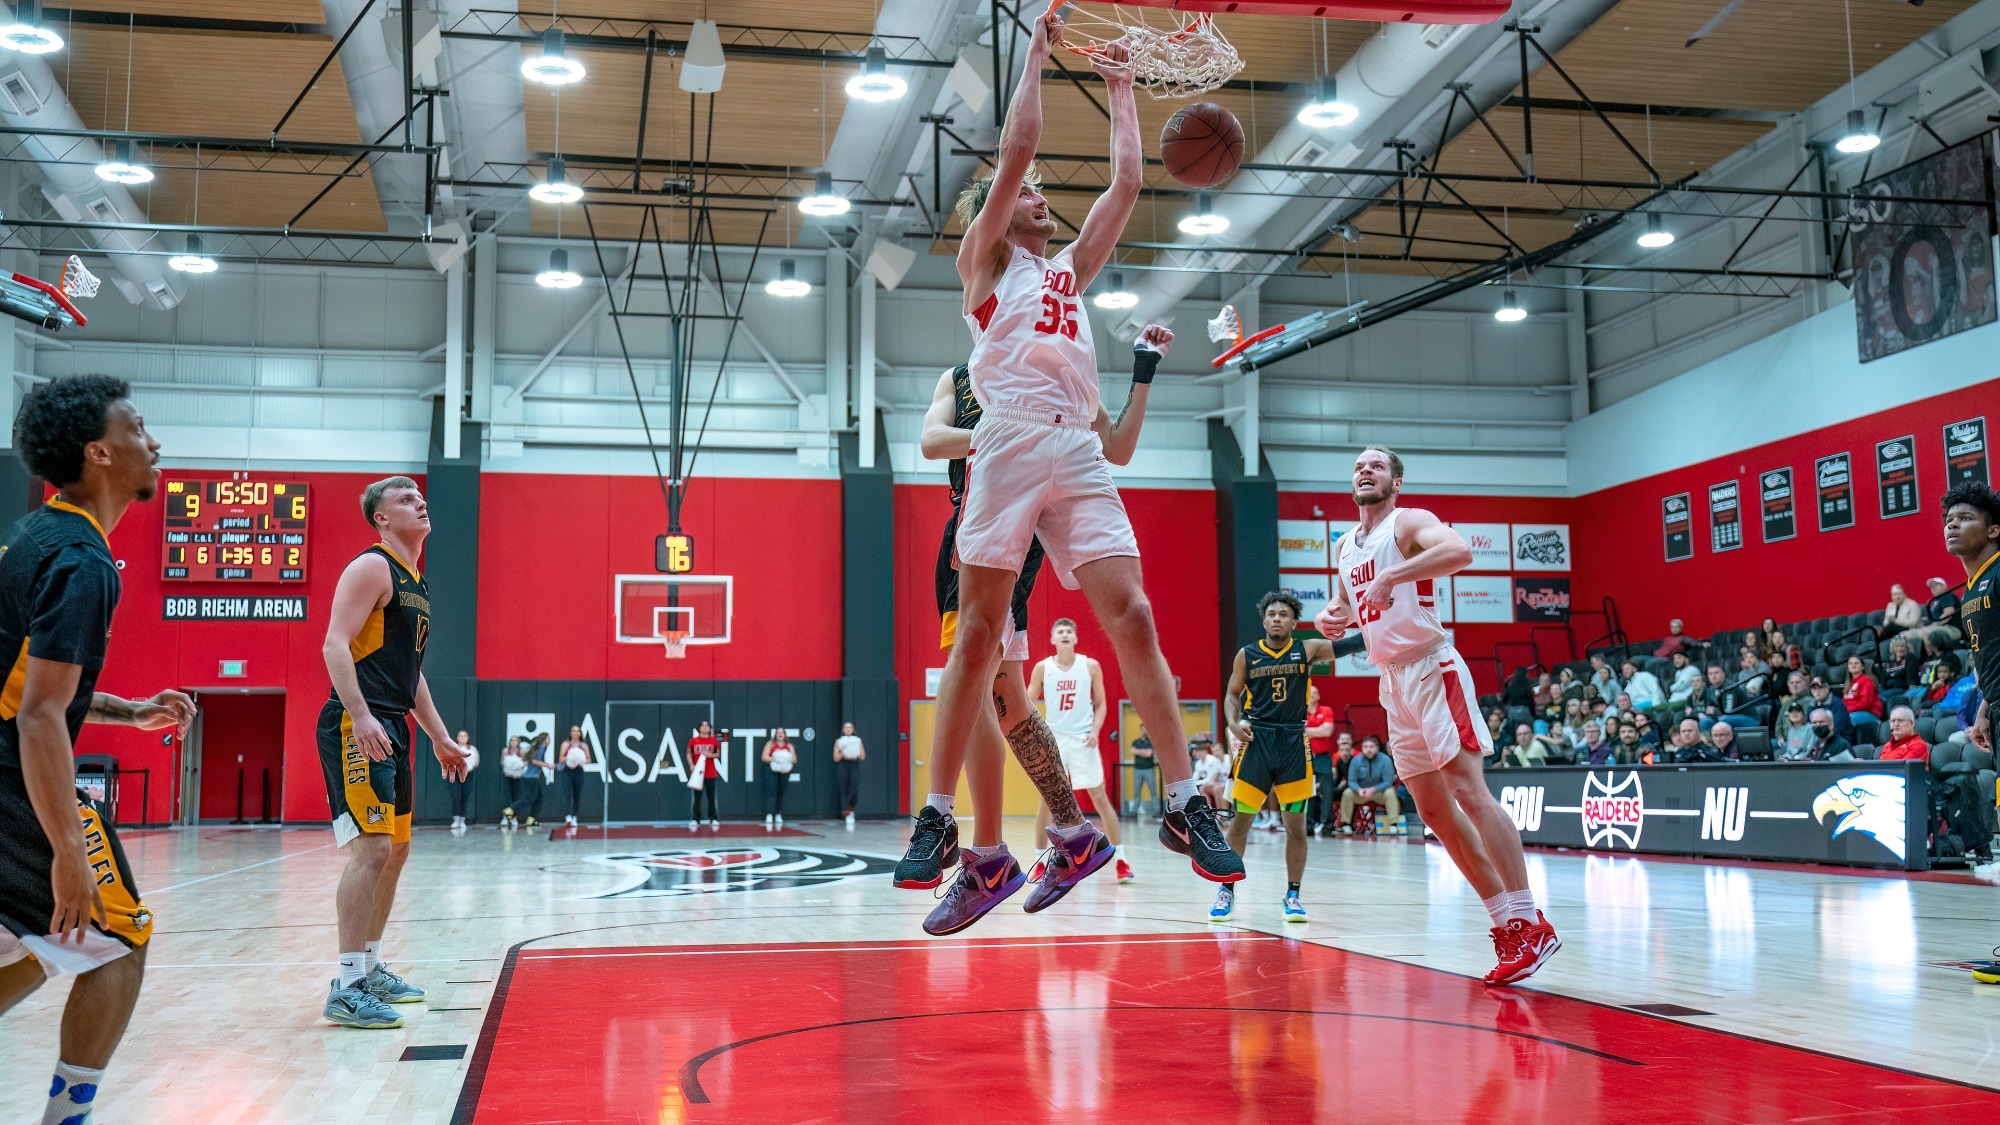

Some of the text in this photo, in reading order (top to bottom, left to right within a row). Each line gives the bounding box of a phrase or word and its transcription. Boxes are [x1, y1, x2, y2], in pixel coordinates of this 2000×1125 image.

[1042, 269, 1077, 297] SOU
[1034, 294, 1078, 341] 35
[216, 482, 267, 505] 15:50
[1711, 486, 1736, 502] RAIDERS
[186, 495, 199, 517] 9
[292, 496, 305, 519] 6
[223, 517, 249, 529] period
[168, 532, 188, 543] fouls
[222, 532, 249, 544] player
[282, 534, 302, 545] fouls
[198, 547, 207, 564] 6
[262, 548, 271, 565] 6
[289, 548, 299, 565] 2
[168, 569, 185, 577] won
[224, 569, 245, 579] game
[283, 570, 299, 578] won
[1351, 560, 1374, 587] SOU
[166, 599, 303, 617] BOB RIEHM ARENA
[1056, 680, 1077, 691] SOU
[1272, 677, 1287, 702] 3
[1059, 693, 1076, 711] 15
[367, 806, 388, 815] NU
[1501, 786, 1748, 841] SOU RAIDERS NU
